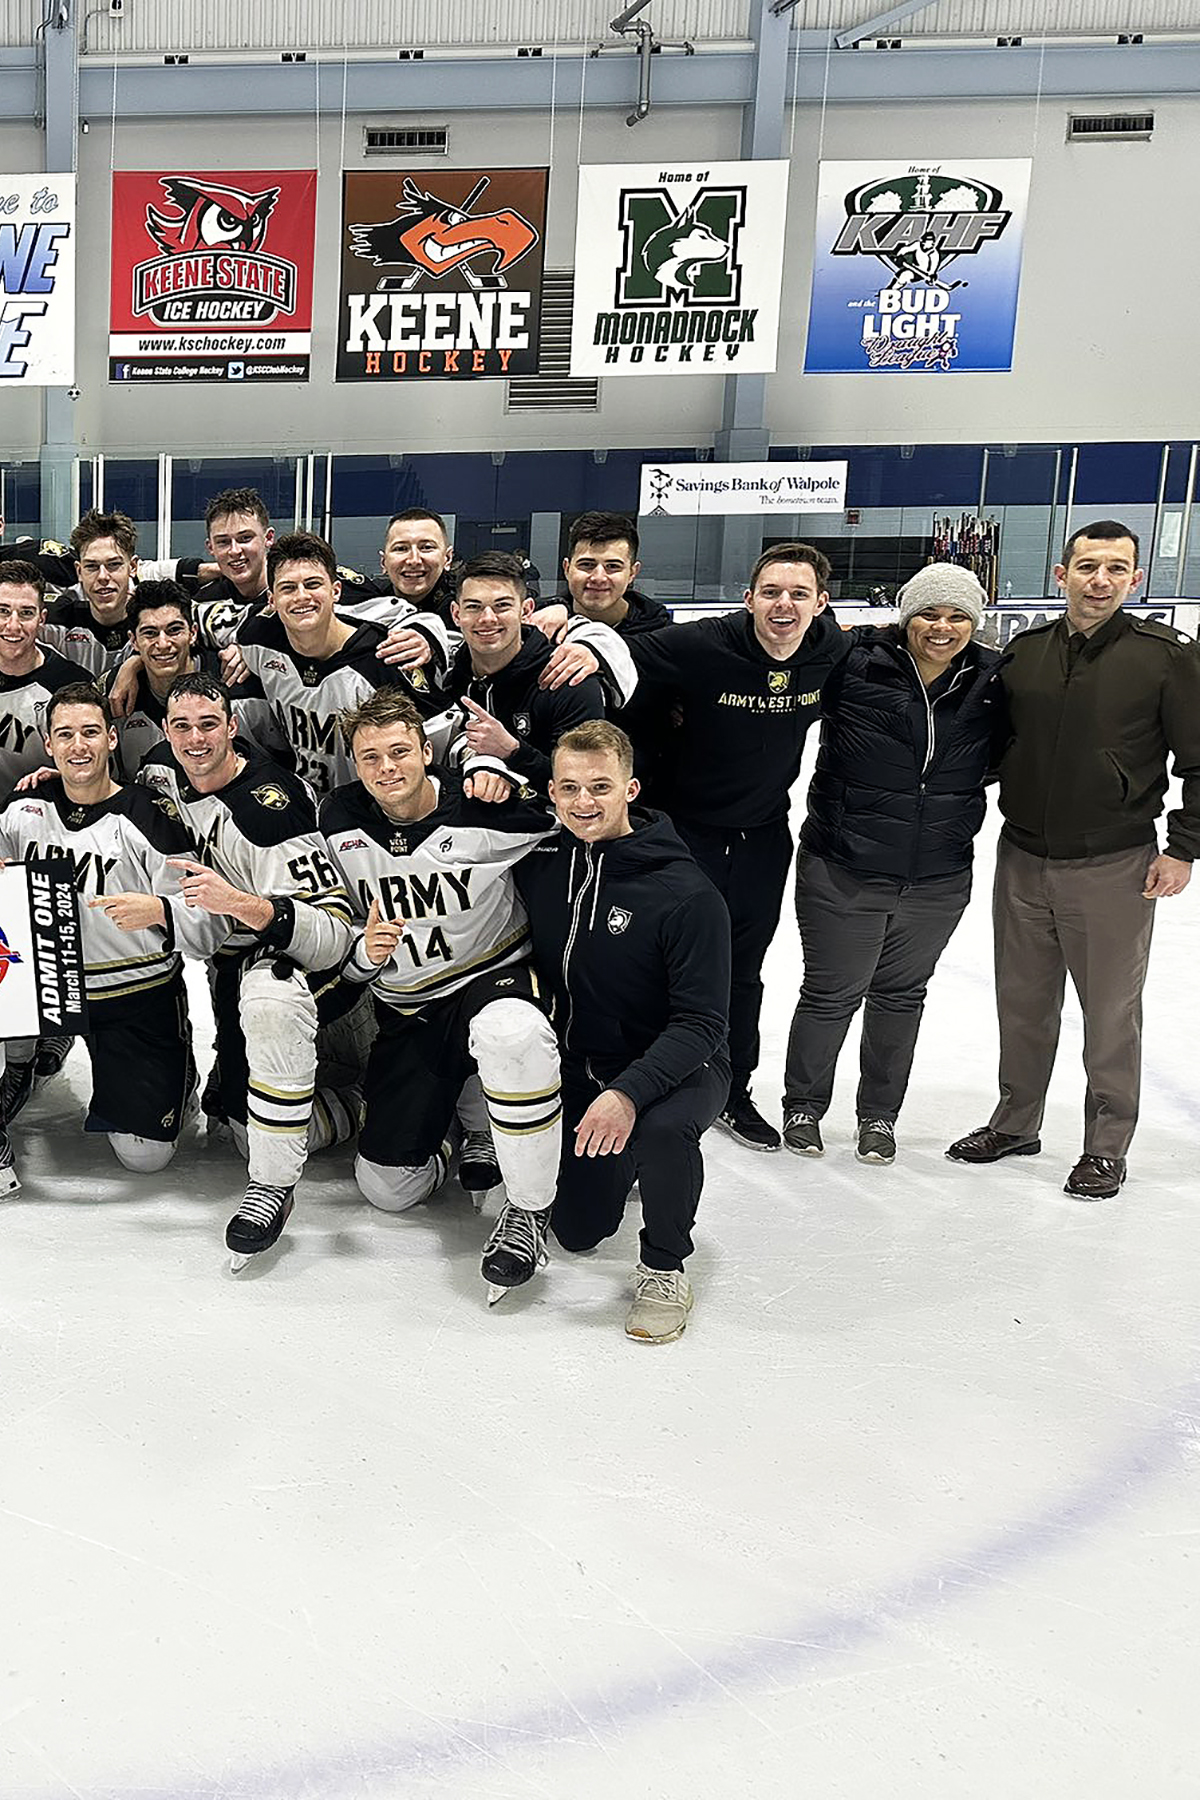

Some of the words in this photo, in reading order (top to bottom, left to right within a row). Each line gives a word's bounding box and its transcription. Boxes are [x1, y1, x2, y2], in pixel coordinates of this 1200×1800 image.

[658, 172, 692, 183] Home
[696, 171, 710, 182] of
[908, 166, 929, 174] Home
[930, 165, 941, 174] of
[30, 186, 59, 216] to
[832, 211, 1011, 254] KAHF
[143, 257, 215, 301] KEENE
[217, 256, 286, 301] STATE
[163, 301, 194, 320] ICE
[195, 300, 266, 320] HOCKEY
[878, 288, 950, 313] BUD
[346, 291, 531, 352] KEENE
[593, 309, 758, 345] MONADNOCK
[863, 314, 961, 339] LIGHT
[138, 336, 286, 353] www.kschockey.com
[366, 350, 512, 373] HOCKEY
[605, 344, 739, 363] HOCKEY
[675, 478, 730, 494] Savings
[732, 478, 769, 491] Bank
[769, 477, 785, 494] of
[787, 477, 840, 492] Walpole
[718, 692, 756, 708] ARMY
[758, 696, 792, 709] WEST
[287, 849, 339, 894] 56
[31, 871, 53, 927] ONE
[55, 882, 74, 918] 2024
[358, 867, 472, 921] ARMY
[59, 921, 78, 965] 11-15,
[401, 925, 453, 967] 14
[36, 933, 62, 1026] ADMIT
[63, 970, 82, 1013] March
